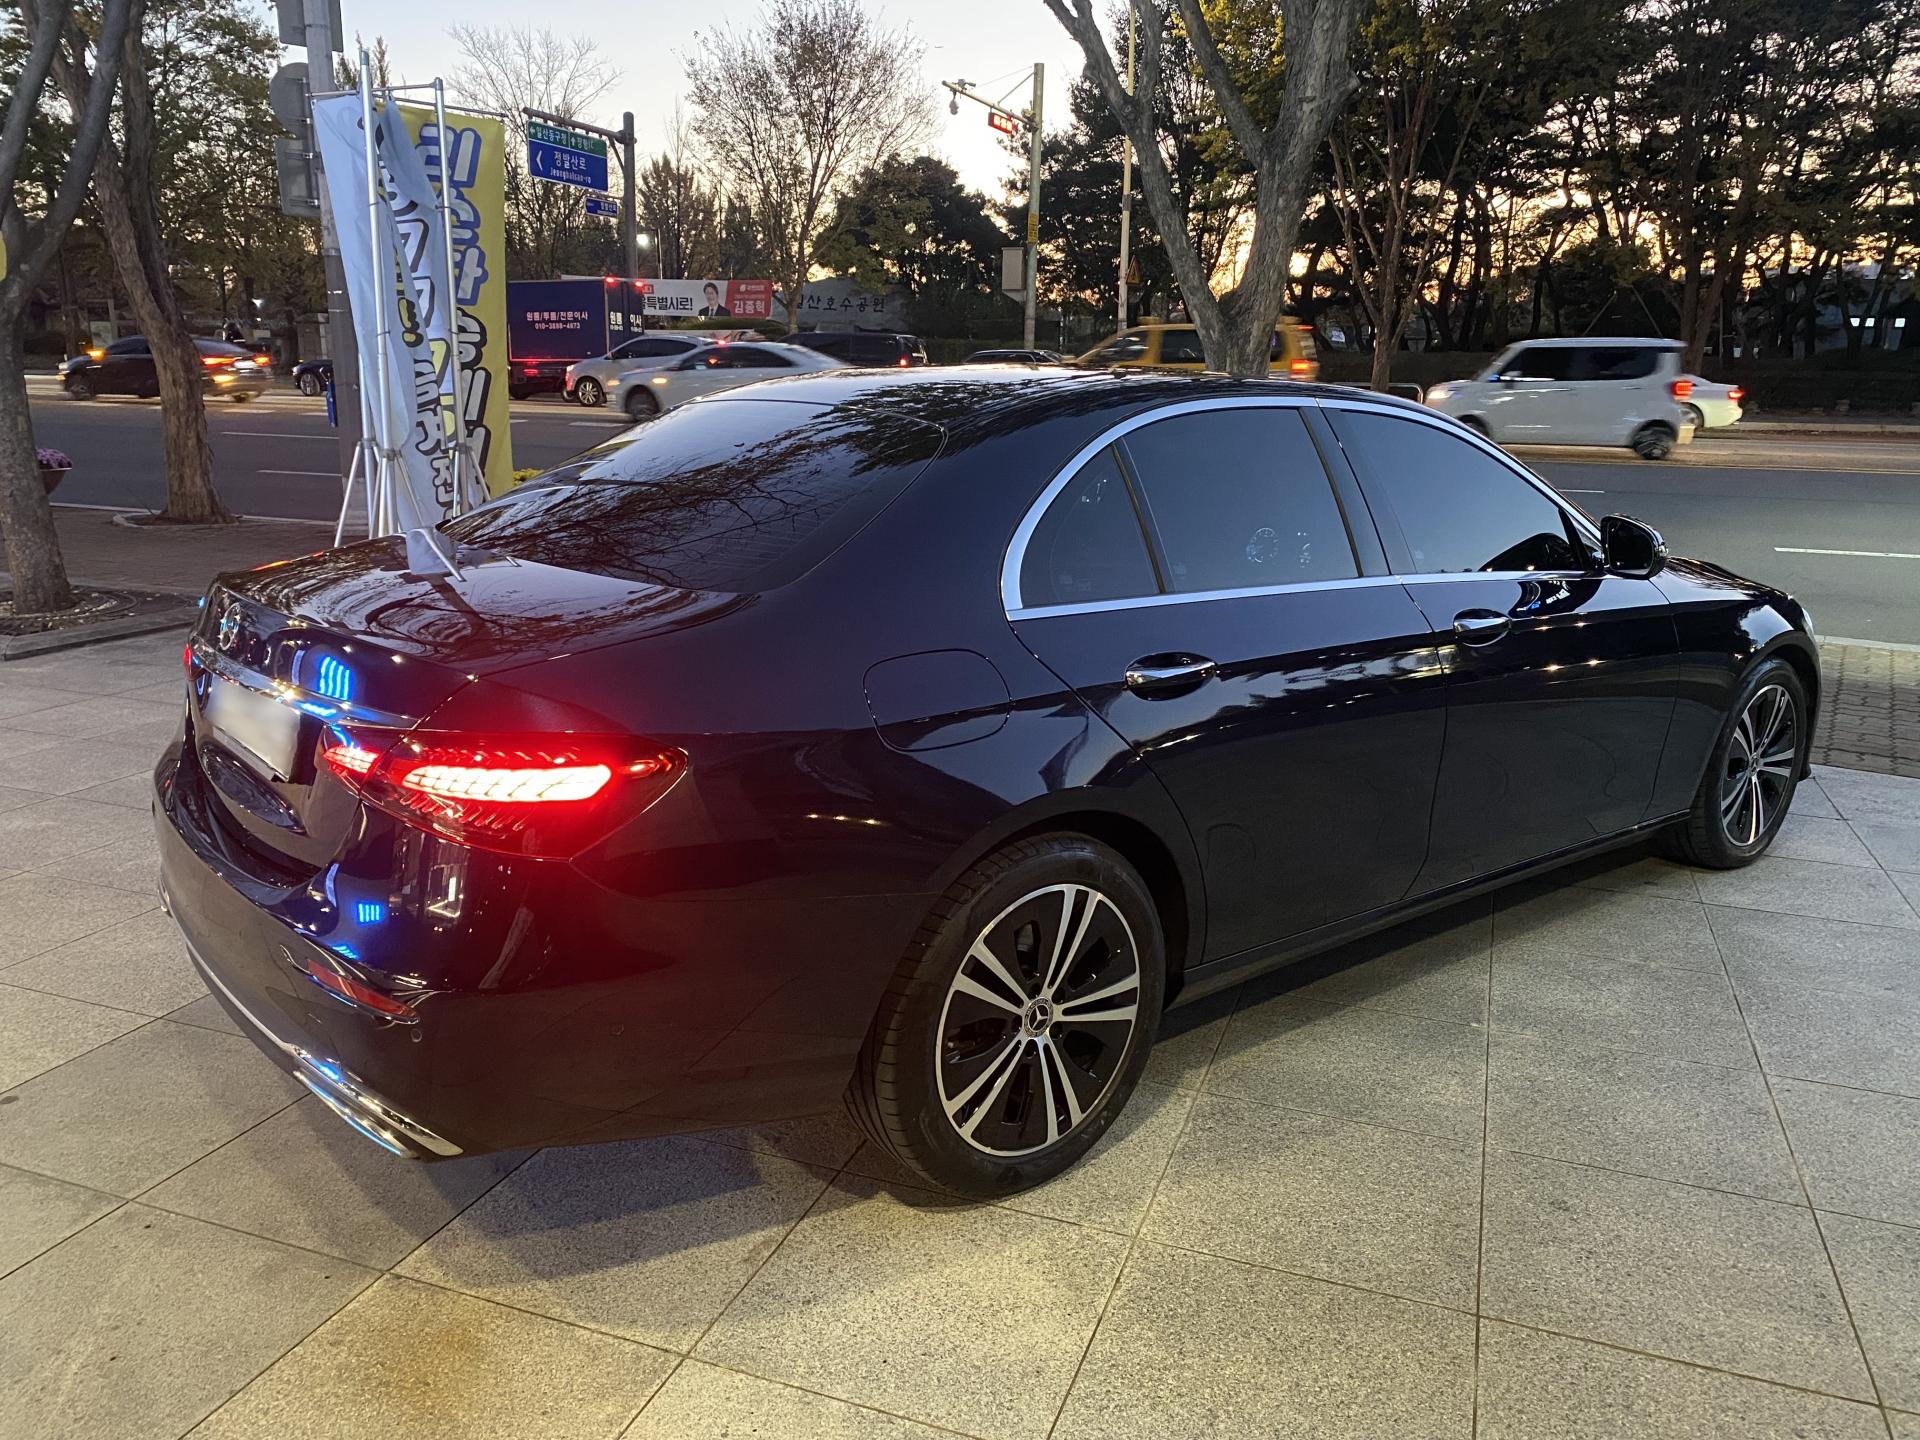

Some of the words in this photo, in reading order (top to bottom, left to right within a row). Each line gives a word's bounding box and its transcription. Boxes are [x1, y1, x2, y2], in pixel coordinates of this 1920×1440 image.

[554, 151, 587, 170] 정발산로
[734, 300, 765, 314] 김종혁
[629, 314, 642, 327] 이사
